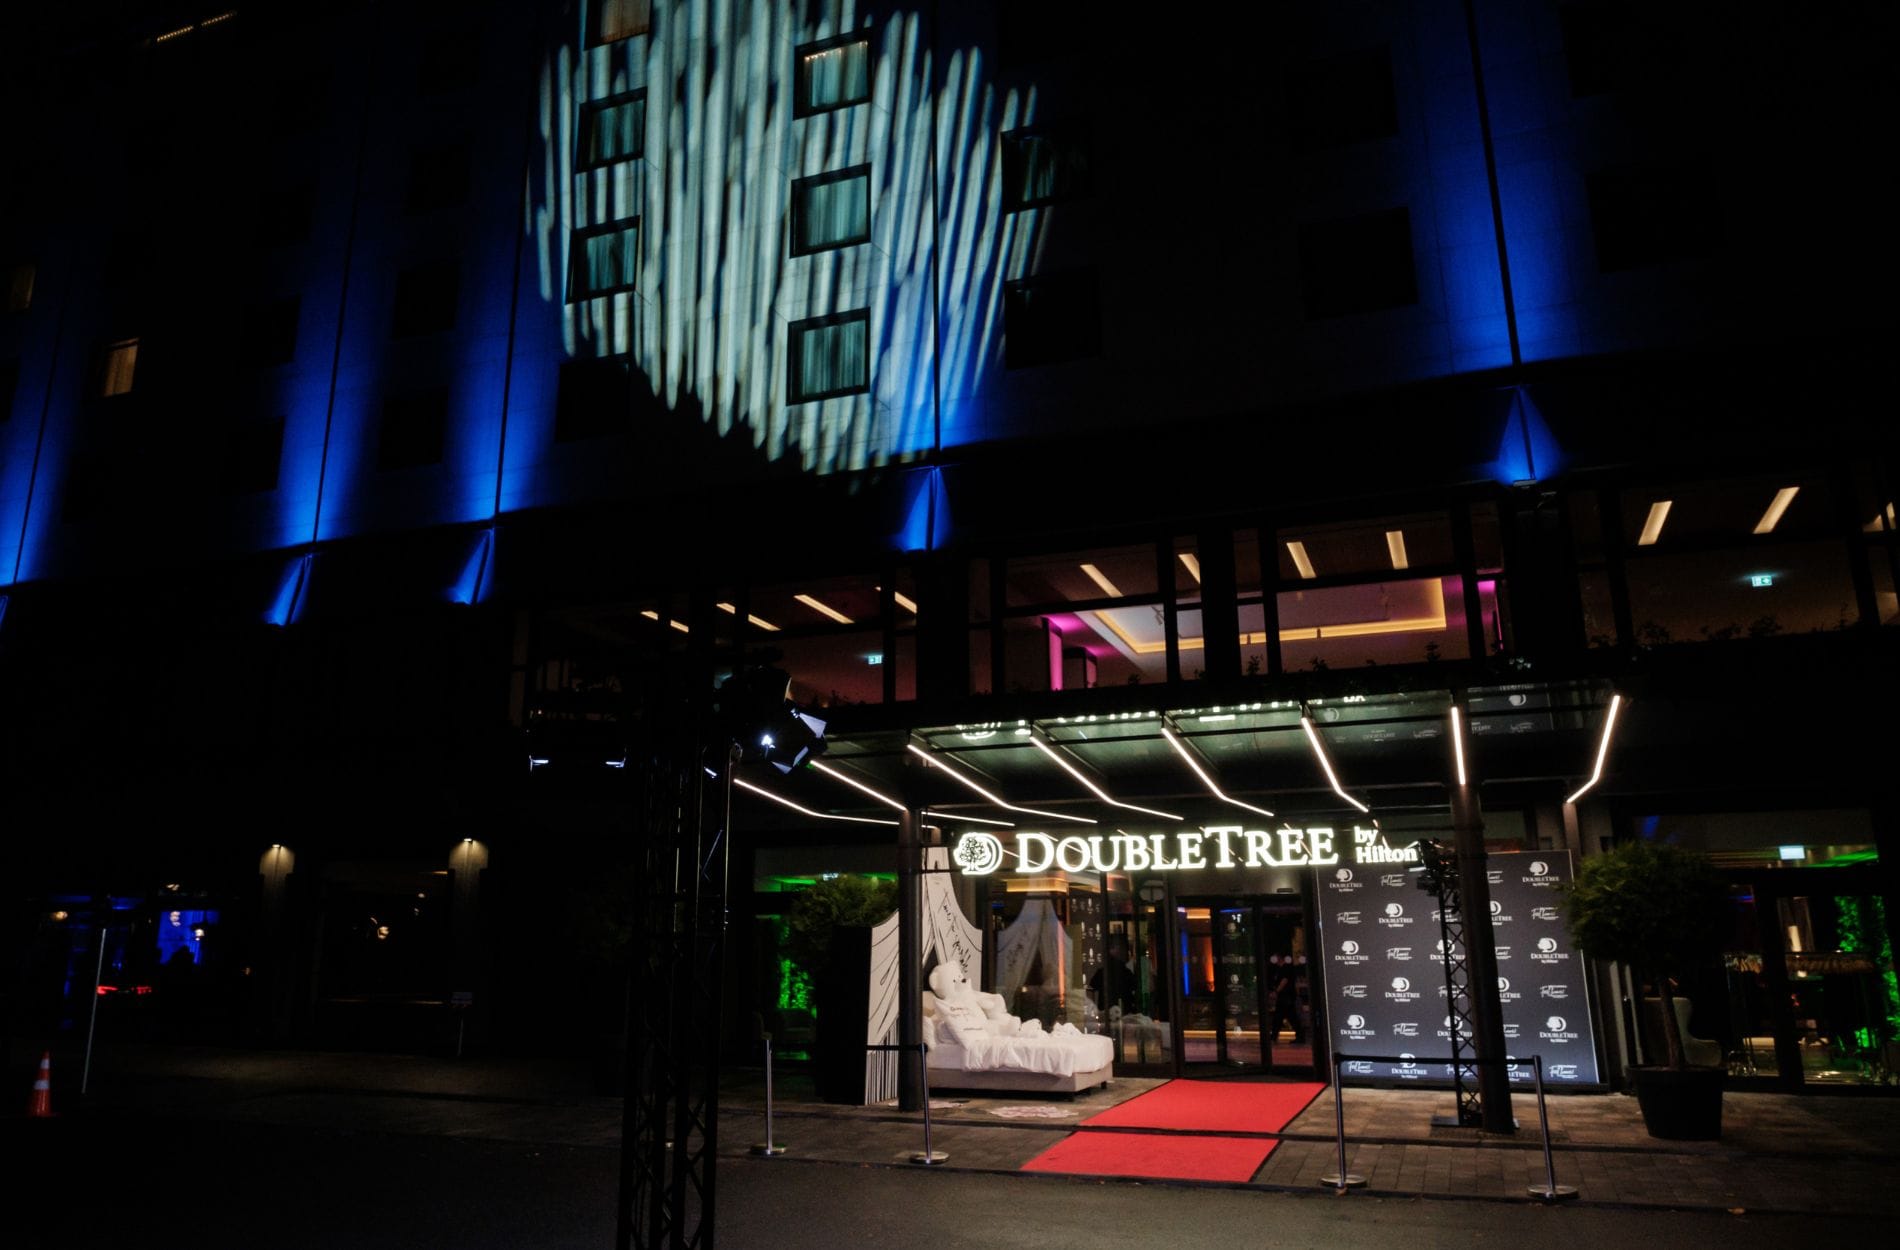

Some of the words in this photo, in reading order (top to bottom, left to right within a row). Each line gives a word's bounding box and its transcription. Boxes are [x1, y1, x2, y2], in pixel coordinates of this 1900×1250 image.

[1353, 825, 1379, 847] by
[1015, 826, 1338, 873] DOUBLETREE
[1355, 846, 1419, 865] Hilton
